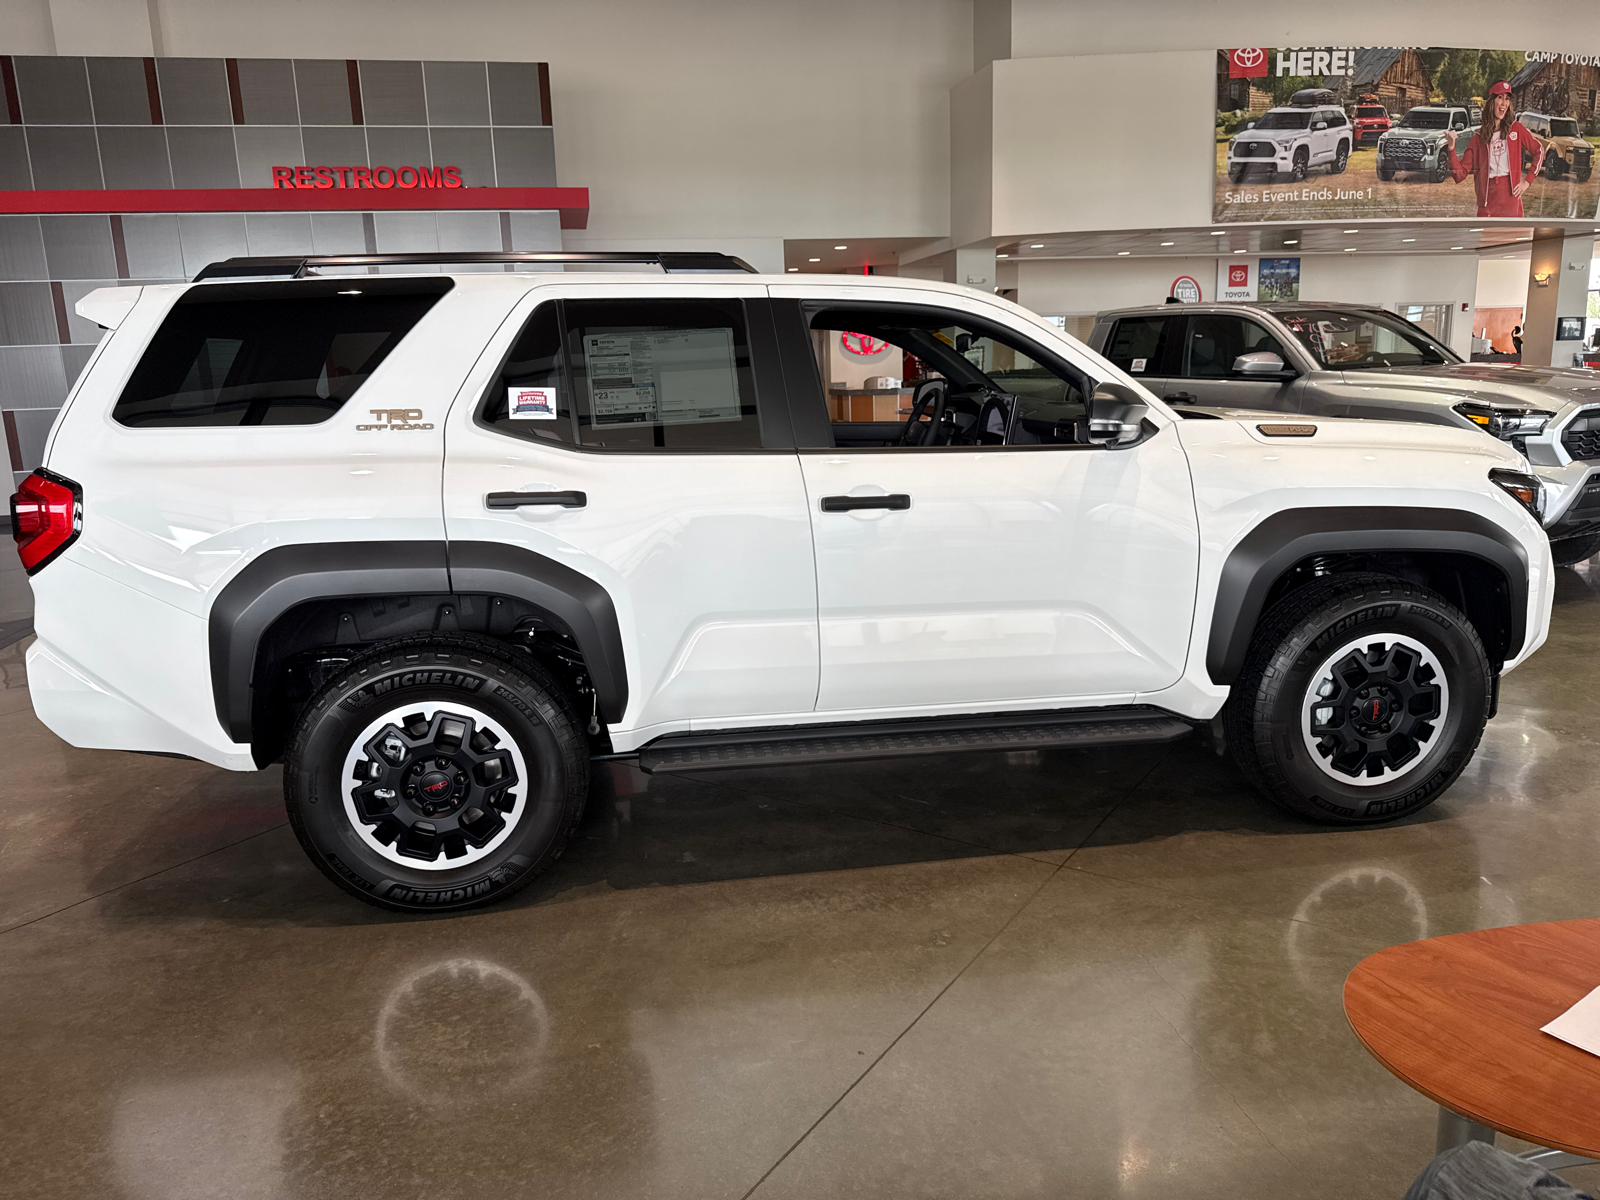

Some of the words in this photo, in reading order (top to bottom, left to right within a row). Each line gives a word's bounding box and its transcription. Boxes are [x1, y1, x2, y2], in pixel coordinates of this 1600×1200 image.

[1276, 51, 1355, 77] HERE!
[1524, 50, 1557, 64] CAMP
[1560, 53, 1600, 68] TOYOTA
[272, 166, 462, 189] RESTROOMS
[1225, 191, 1258, 204] Sales
[1263, 189, 1299, 202] Event
[1302, 188, 1332, 201] Ends
[1335, 188, 1363, 200] June
[1367, 187, 1372, 199] 1
[1177, 288, 1196, 298] TIRE
[598, 391, 608, 400] 23
[370, 409, 423, 424] TRD
[1315, 606, 1396, 648] MICHELIN
[374, 672, 480, 695] MICHELIN
[496, 688, 526, 710] 265/70
[423, 780, 448, 792] TRD
[1368, 772, 1445, 815] MICHELIN
[352, 875, 371, 889] LTX
[388, 879, 492, 904] MICHELIN
